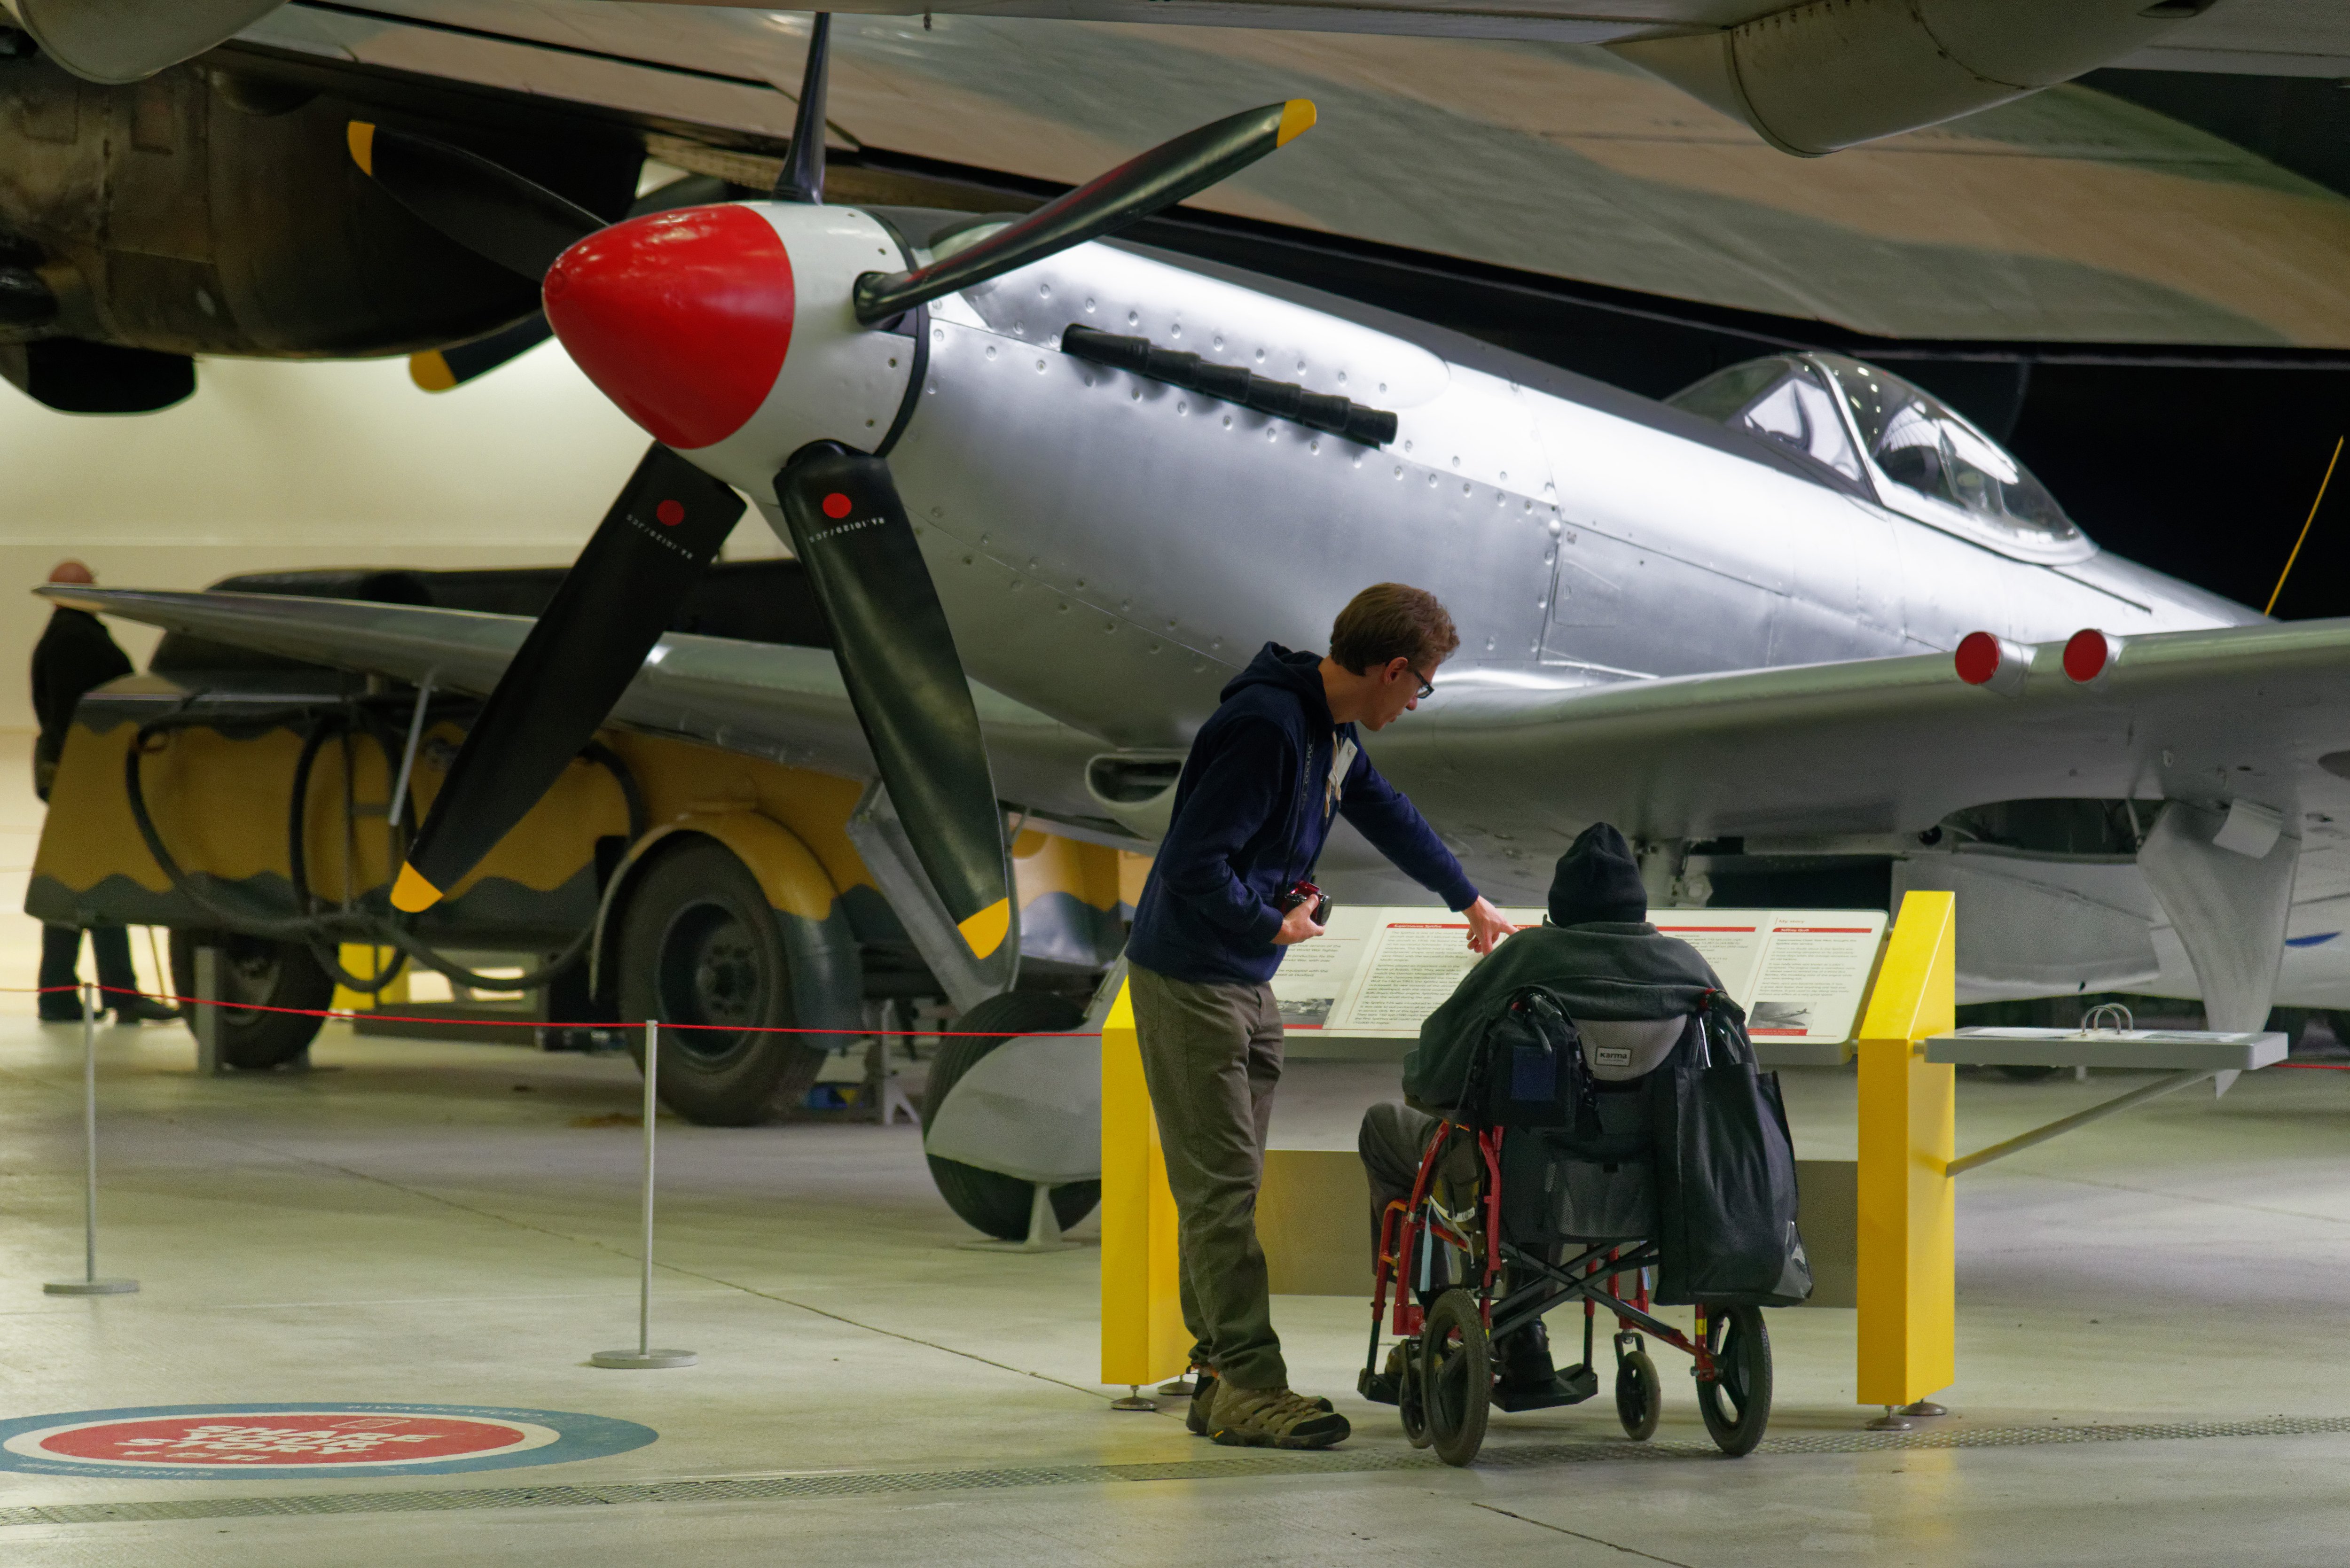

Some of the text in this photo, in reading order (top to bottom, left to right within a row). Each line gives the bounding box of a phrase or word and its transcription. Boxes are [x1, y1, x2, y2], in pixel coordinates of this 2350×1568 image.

[182, 1432, 384, 1448] YOUR
[183, 1425, 446, 1443] SHARE
[115, 1438, 374, 1454] STORY
